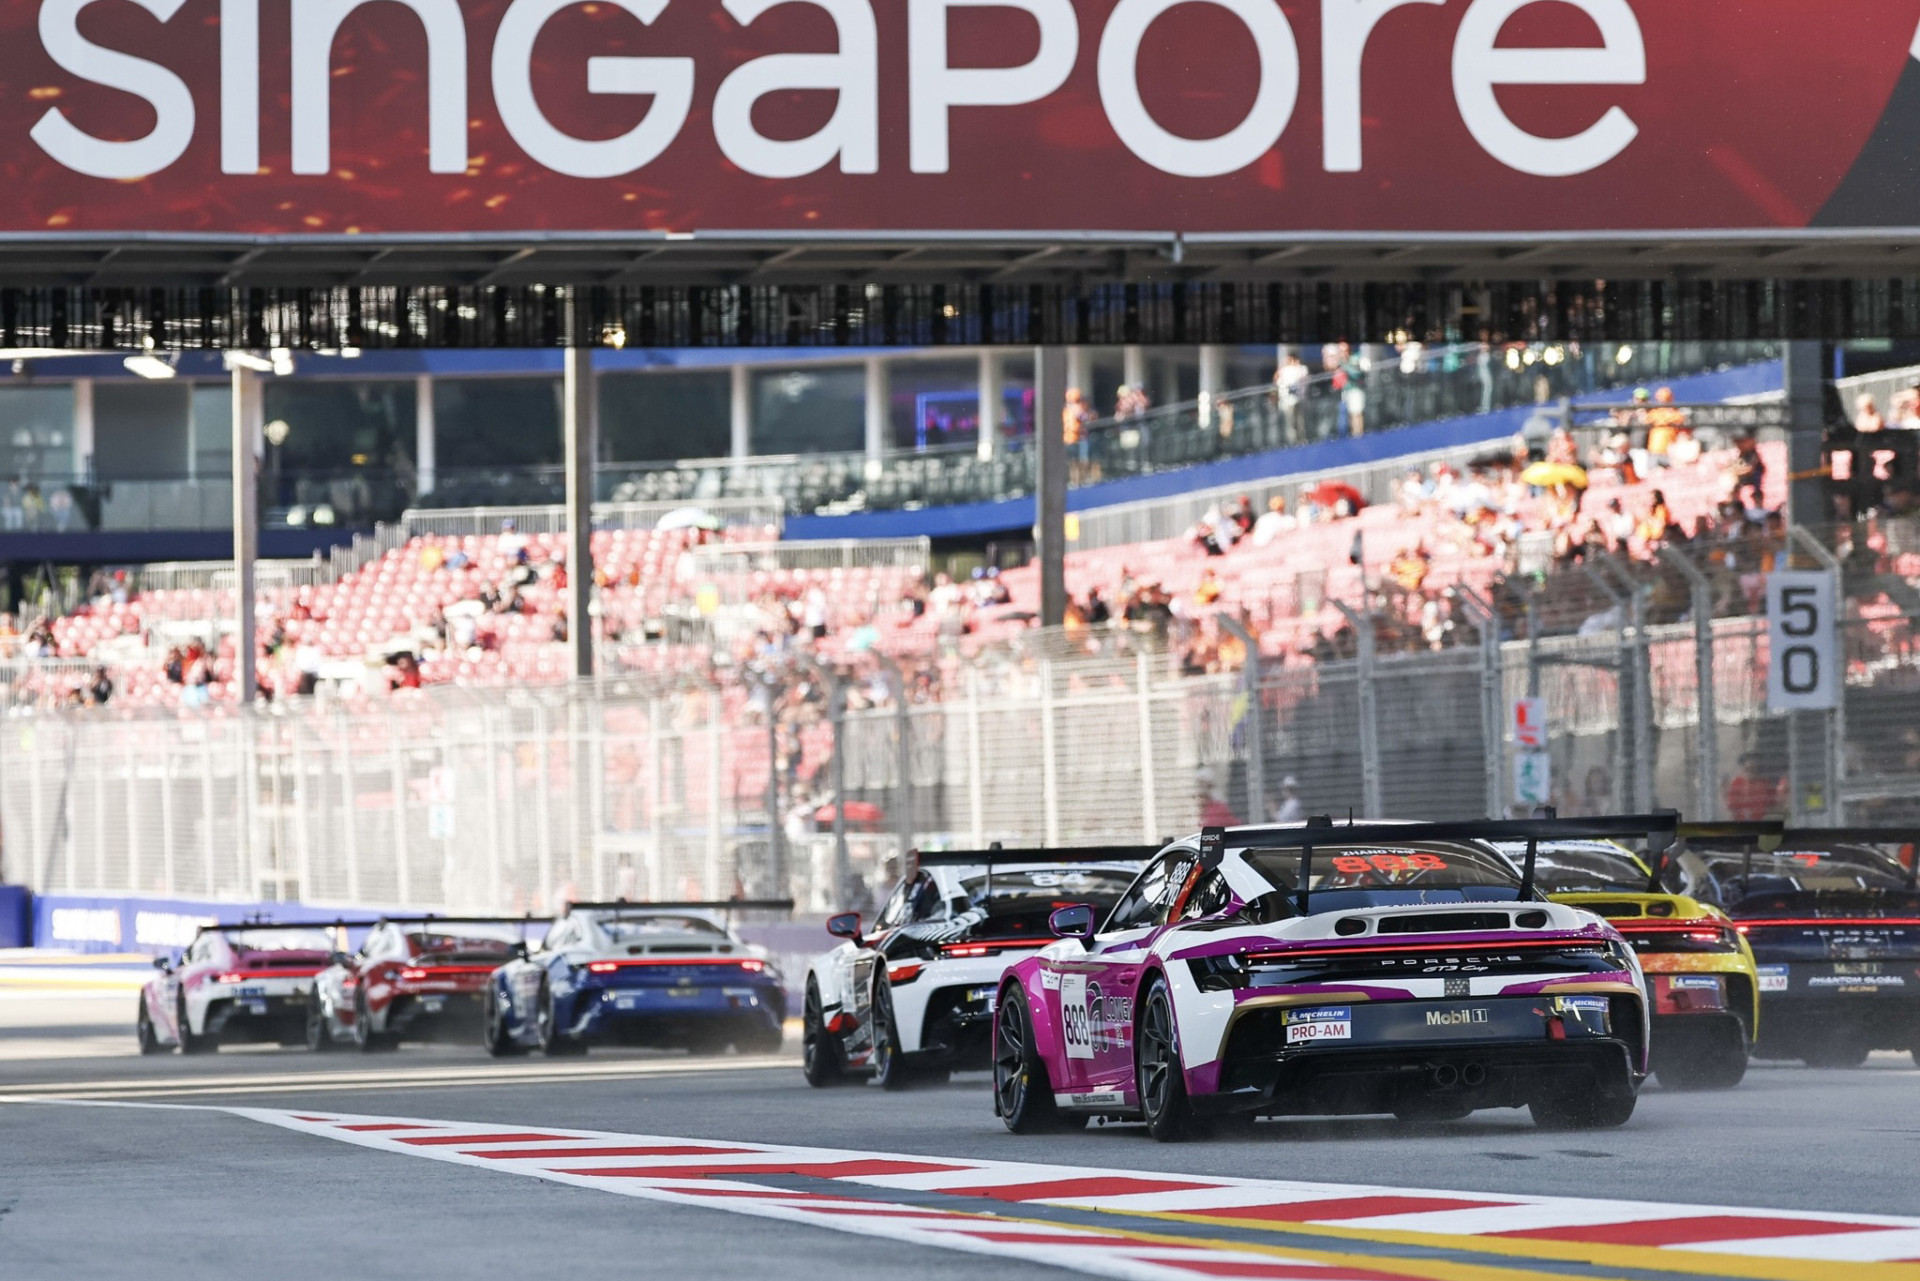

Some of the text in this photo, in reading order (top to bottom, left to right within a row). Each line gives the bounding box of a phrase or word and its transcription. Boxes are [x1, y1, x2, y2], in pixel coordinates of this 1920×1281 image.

[1331, 854, 1448, 873] 888
[1031, 874, 1088, 887] 84
[1169, 861, 1192, 884] 888
[1381, 955, 1522, 966] PORSCHE
[1422, 964, 1489, 973] GT3 Cup
[1300, 1010, 1345, 1019] MICHELIN
[1425, 1009, 1470, 1025] Mobil
[1063, 1004, 1089, 1046] 888
[1292, 1024, 1345, 1040] PRO-AM
